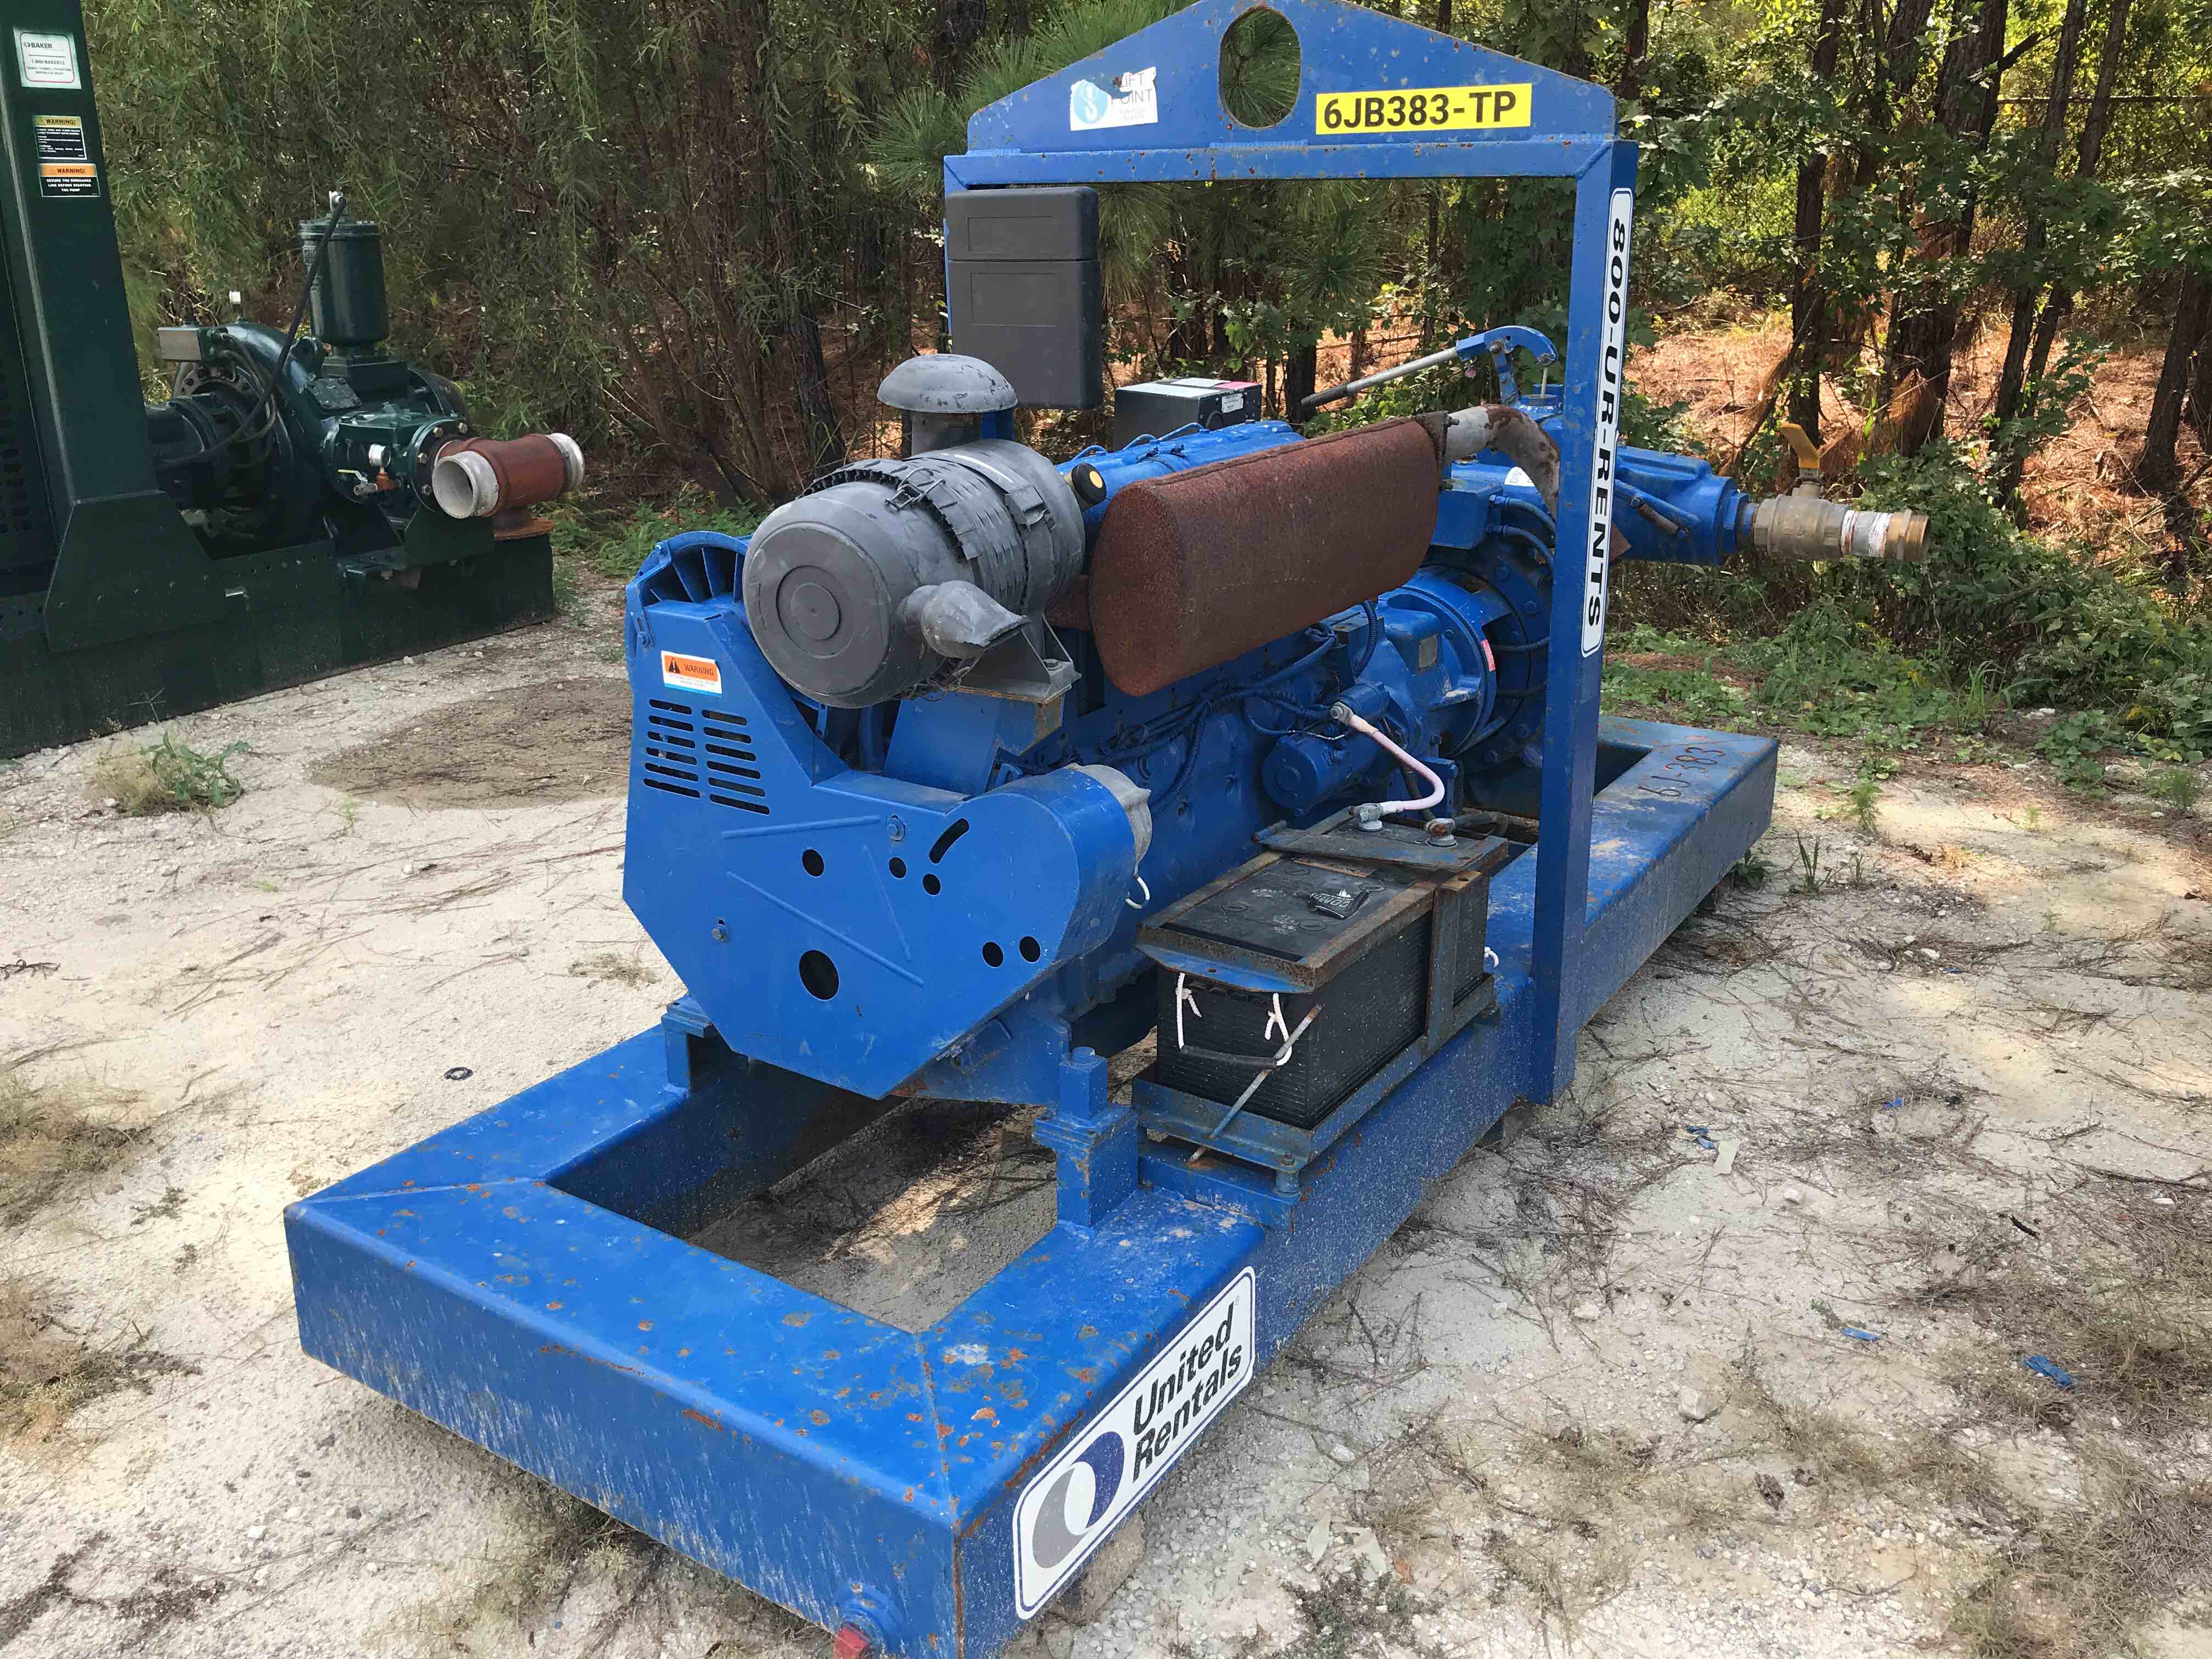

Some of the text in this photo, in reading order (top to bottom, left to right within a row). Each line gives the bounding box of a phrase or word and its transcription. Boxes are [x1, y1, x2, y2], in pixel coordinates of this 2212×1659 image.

[1121, 72, 1145, 87] IFT
[1324, 91, 1516, 129] 6JB383-TP
[1588, 218, 1625, 627] 800-UR-RENTS
[684, 663, 715, 676] WARNING
[1133, 1302, 1234, 1436] United
[1132, 1344, 1243, 1483] Rentals
